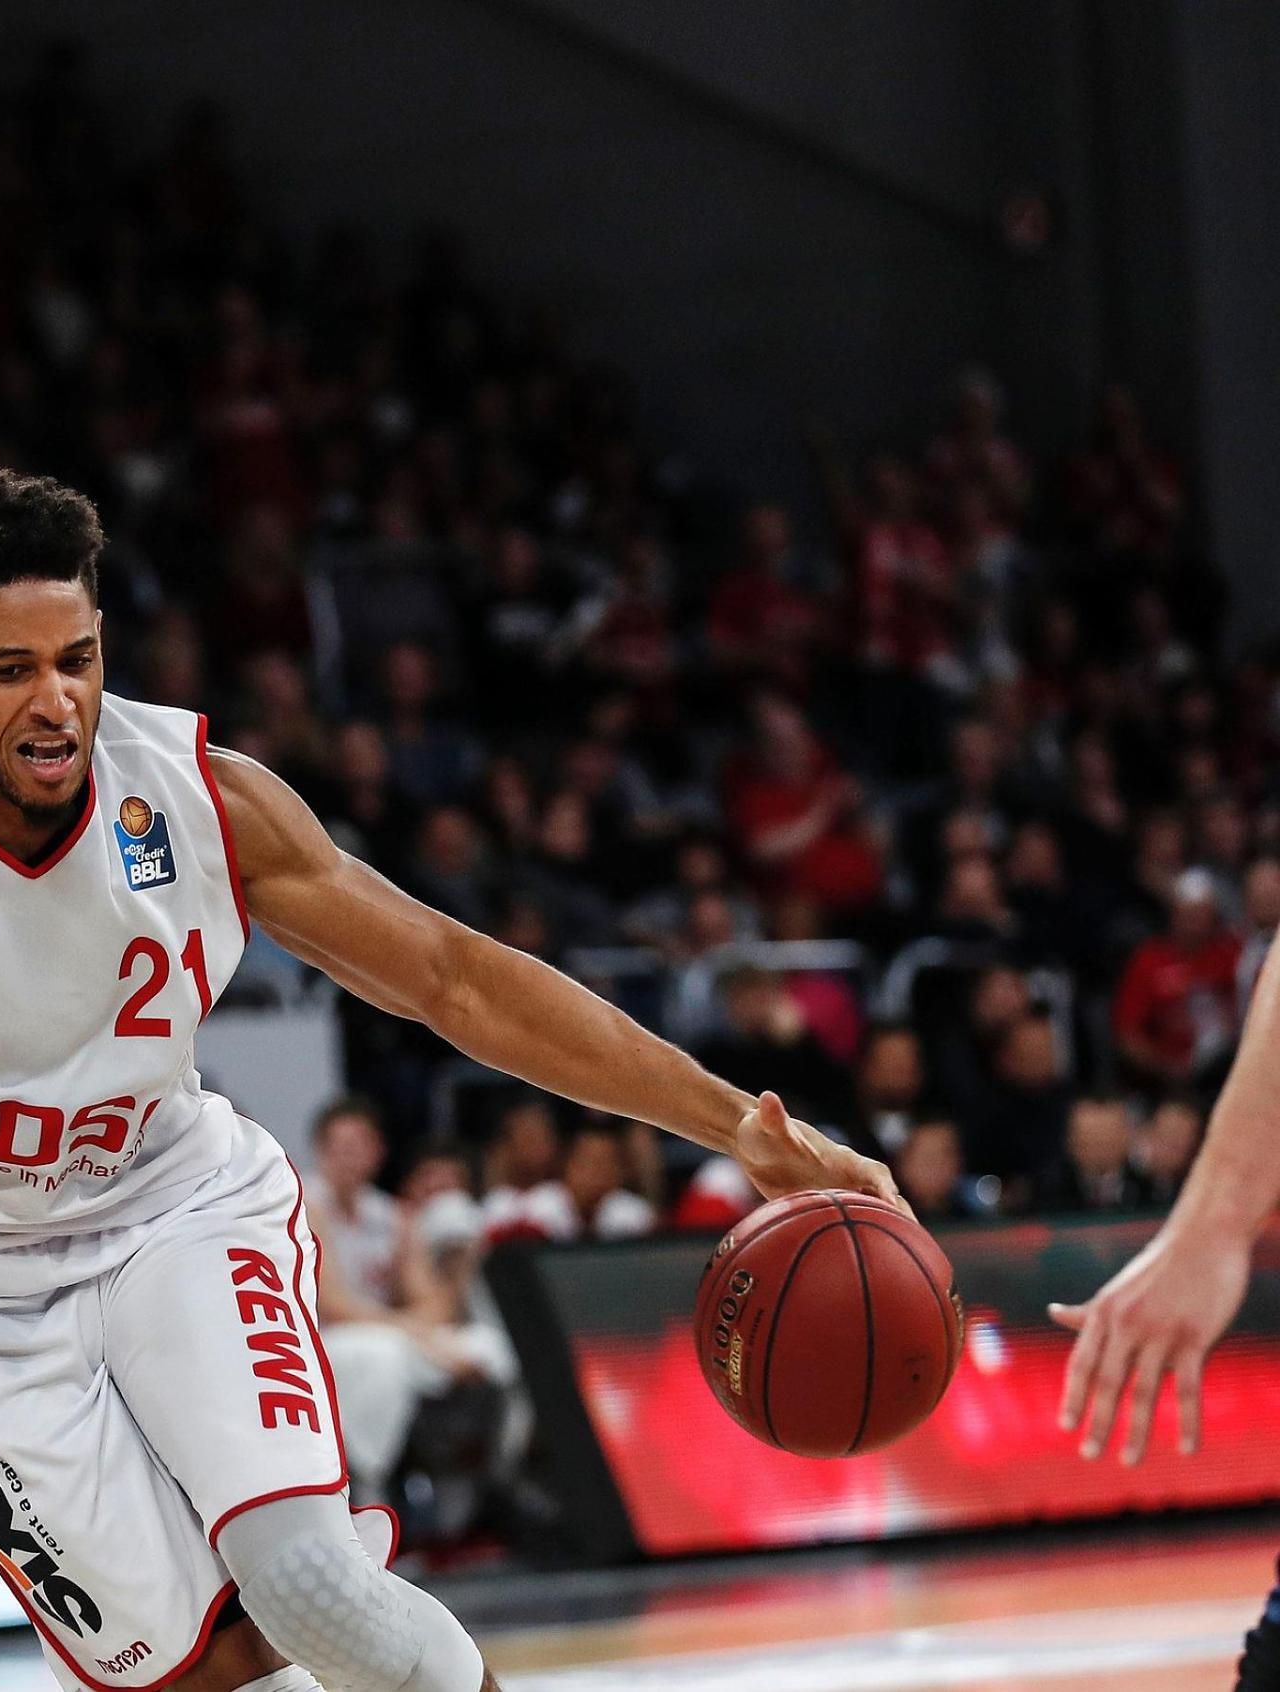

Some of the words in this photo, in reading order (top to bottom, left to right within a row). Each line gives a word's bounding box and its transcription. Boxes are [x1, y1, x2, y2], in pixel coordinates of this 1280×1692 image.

[130, 858, 169, 885] BBL
[115, 929, 212, 1037] 21
[227, 1248, 321, 1434] REWE
[0, 1460, 24, 1493] car
[19, 1498, 32, 1512] a
[29, 1516, 64, 1557] rent
